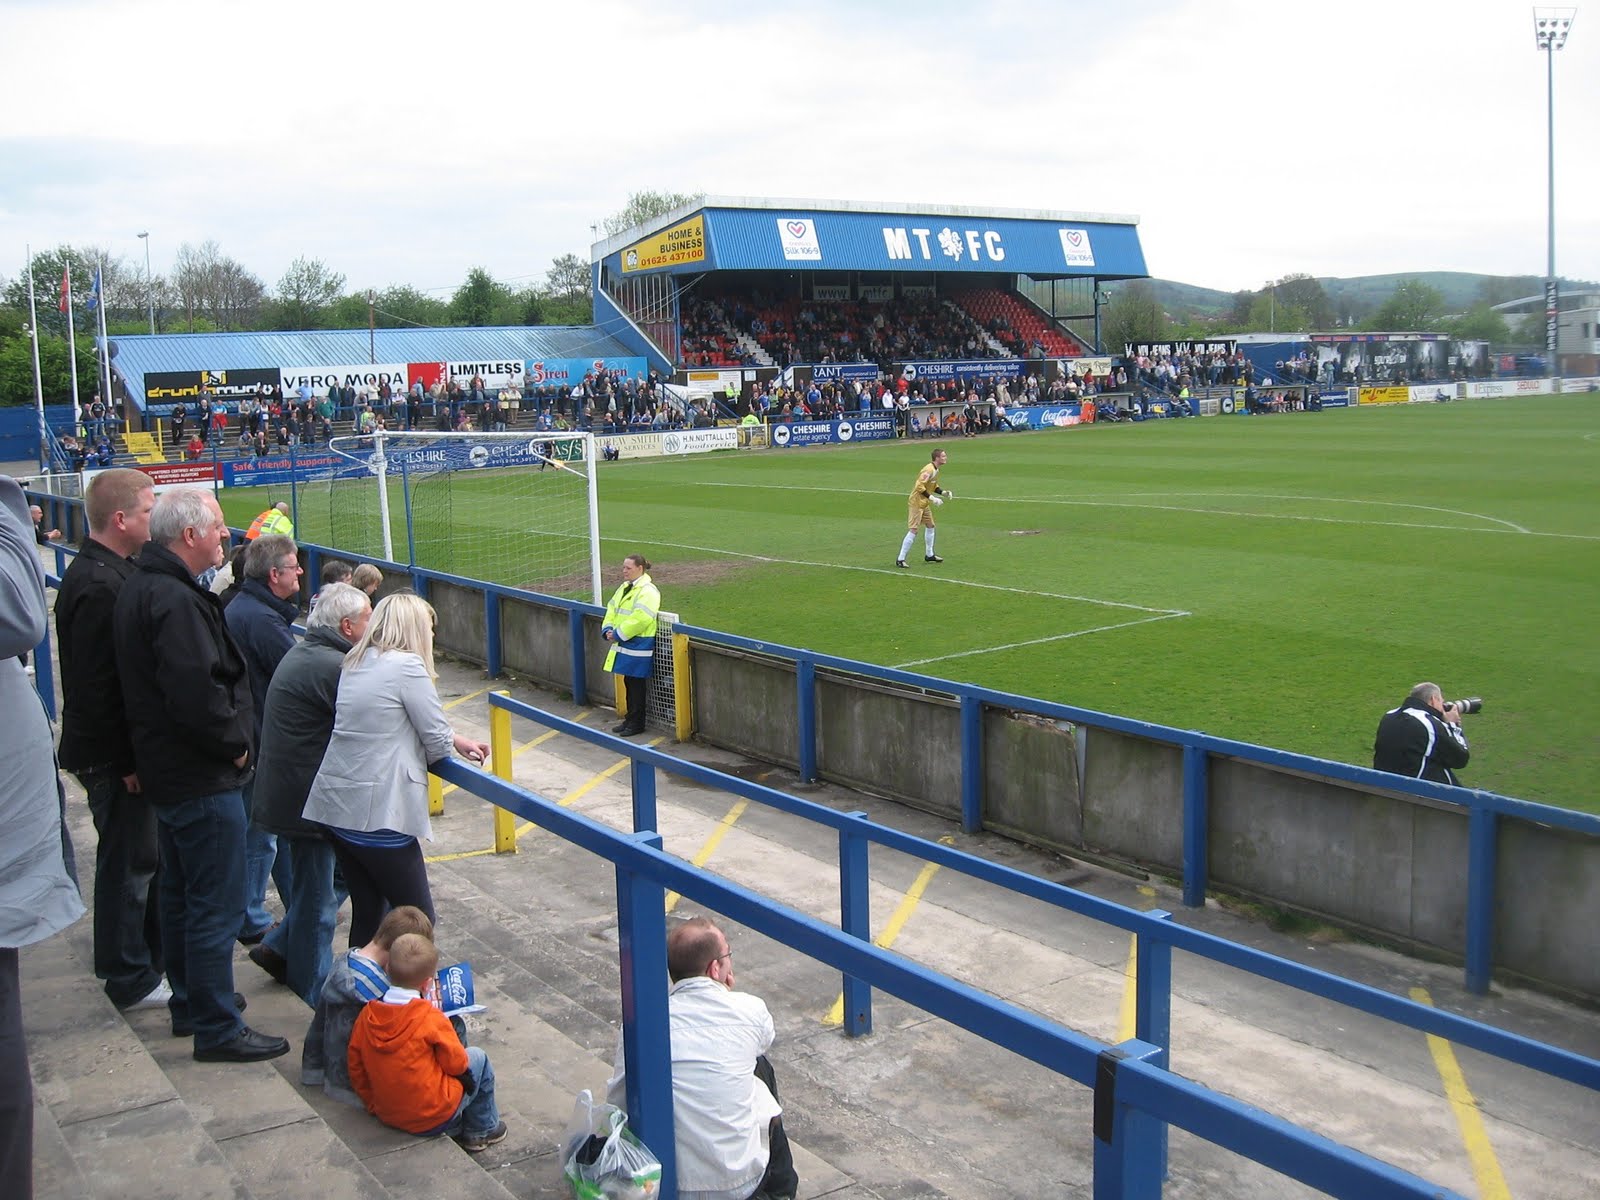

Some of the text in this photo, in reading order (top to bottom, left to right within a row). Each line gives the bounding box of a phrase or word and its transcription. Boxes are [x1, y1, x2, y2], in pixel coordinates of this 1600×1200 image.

[668, 226, 702, 241] HOME &
[660, 238, 702, 254] BUSINESS
[641, 255, 667, 267] 01625
[669, 249, 703, 262] 437100
[450, 363, 522, 376] LIMITLESS
[532, 360, 627, 383] Siren Sren
[918, 365, 954, 374] CHESHIRE
[283, 372, 404, 389] VERO MODA
[792, 421, 891, 434] CHESHIRE CHESHIRE
[725, 432, 737, 440] LTD
[811, 433, 832, 442] agency
[873, 430, 892, 438] agency
[594, 435, 660, 446] NDREW SMITH
[684, 441, 736, 450] Foodservice
[258, 460, 291, 470] friendly
